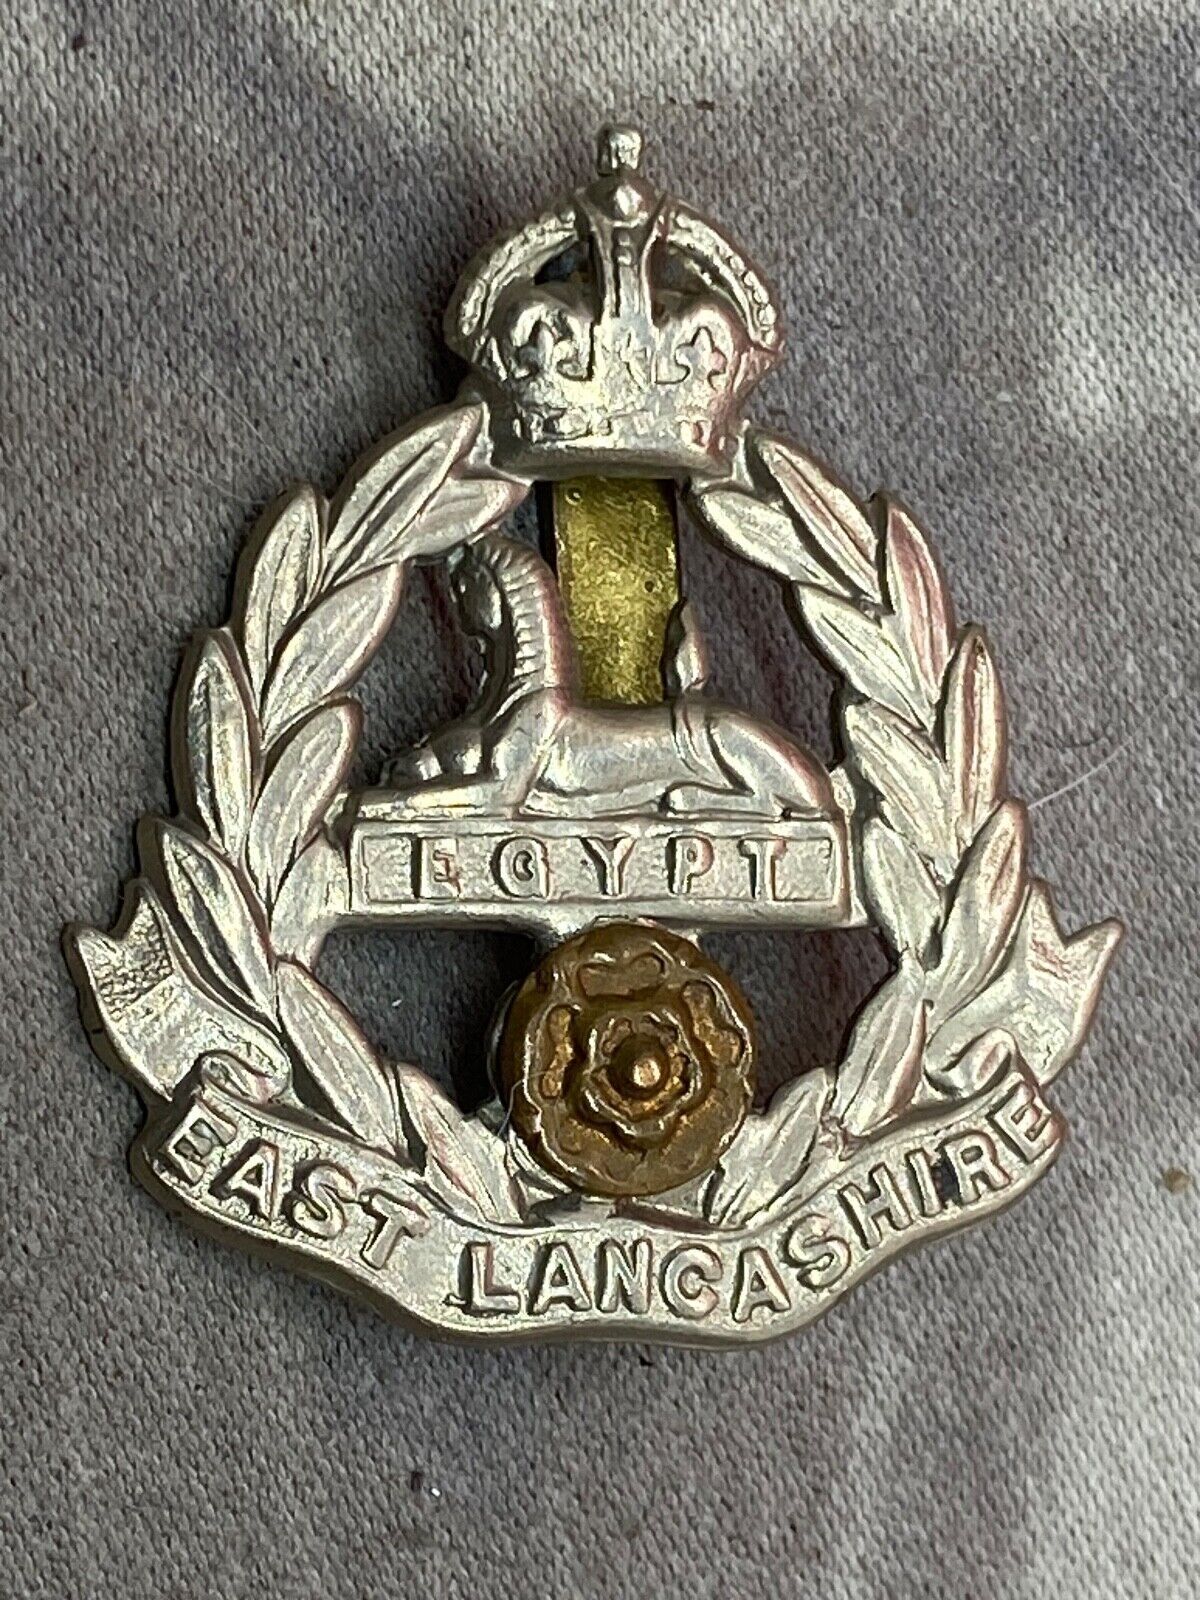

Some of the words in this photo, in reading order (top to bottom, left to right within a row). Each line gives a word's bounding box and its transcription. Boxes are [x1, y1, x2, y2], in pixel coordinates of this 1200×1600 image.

[413, 835, 787, 900] EGYPT
[163, 1101, 430, 1270] EAST
[460, 1079, 1055, 1322] LANCASHIRE
